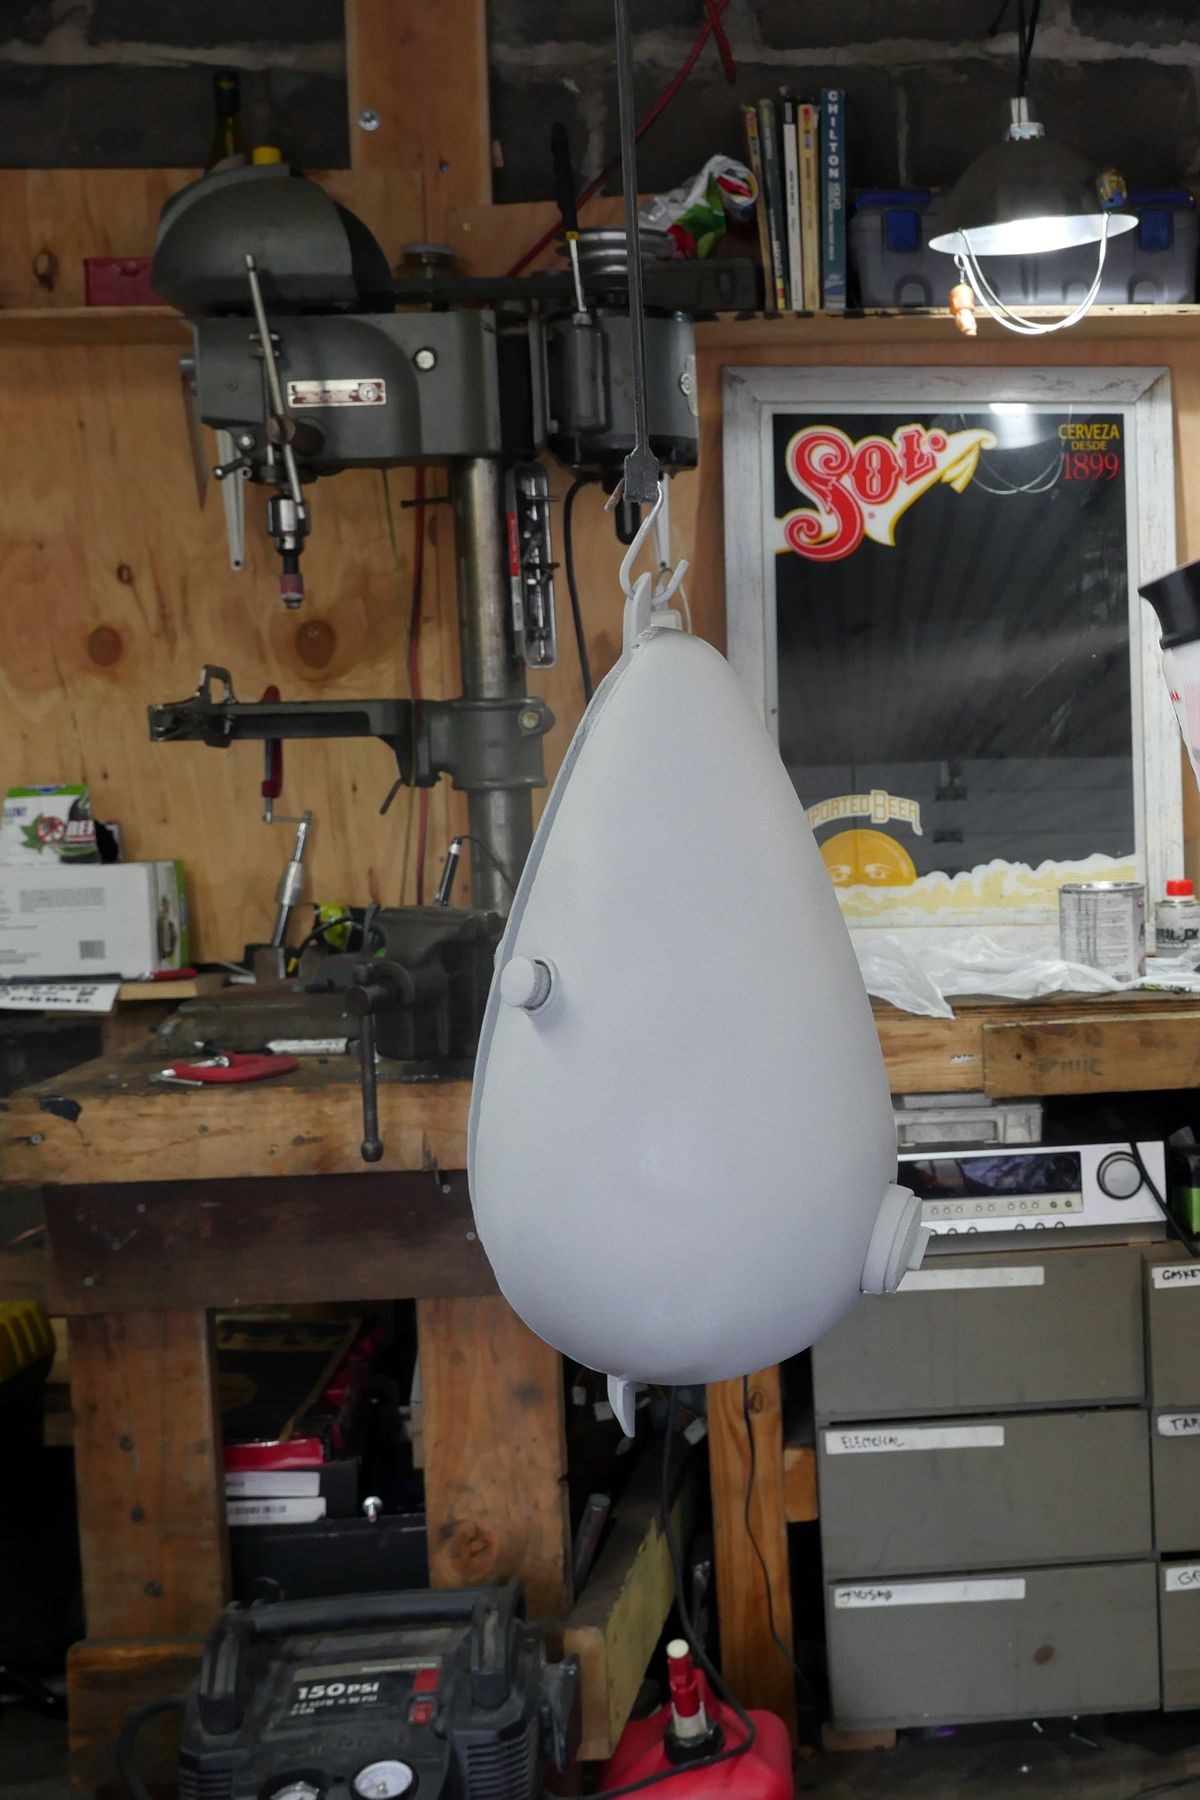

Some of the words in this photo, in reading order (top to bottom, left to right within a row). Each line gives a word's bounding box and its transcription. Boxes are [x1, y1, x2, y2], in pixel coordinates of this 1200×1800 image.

[827, 90, 840, 178] CHILTON
[1058, 424, 1120, 440] CERVEZA
[1071, 440, 1108, 451] DESDE
[1064, 451, 1120, 480] 1899
[807, 796, 870, 825] PORTED
